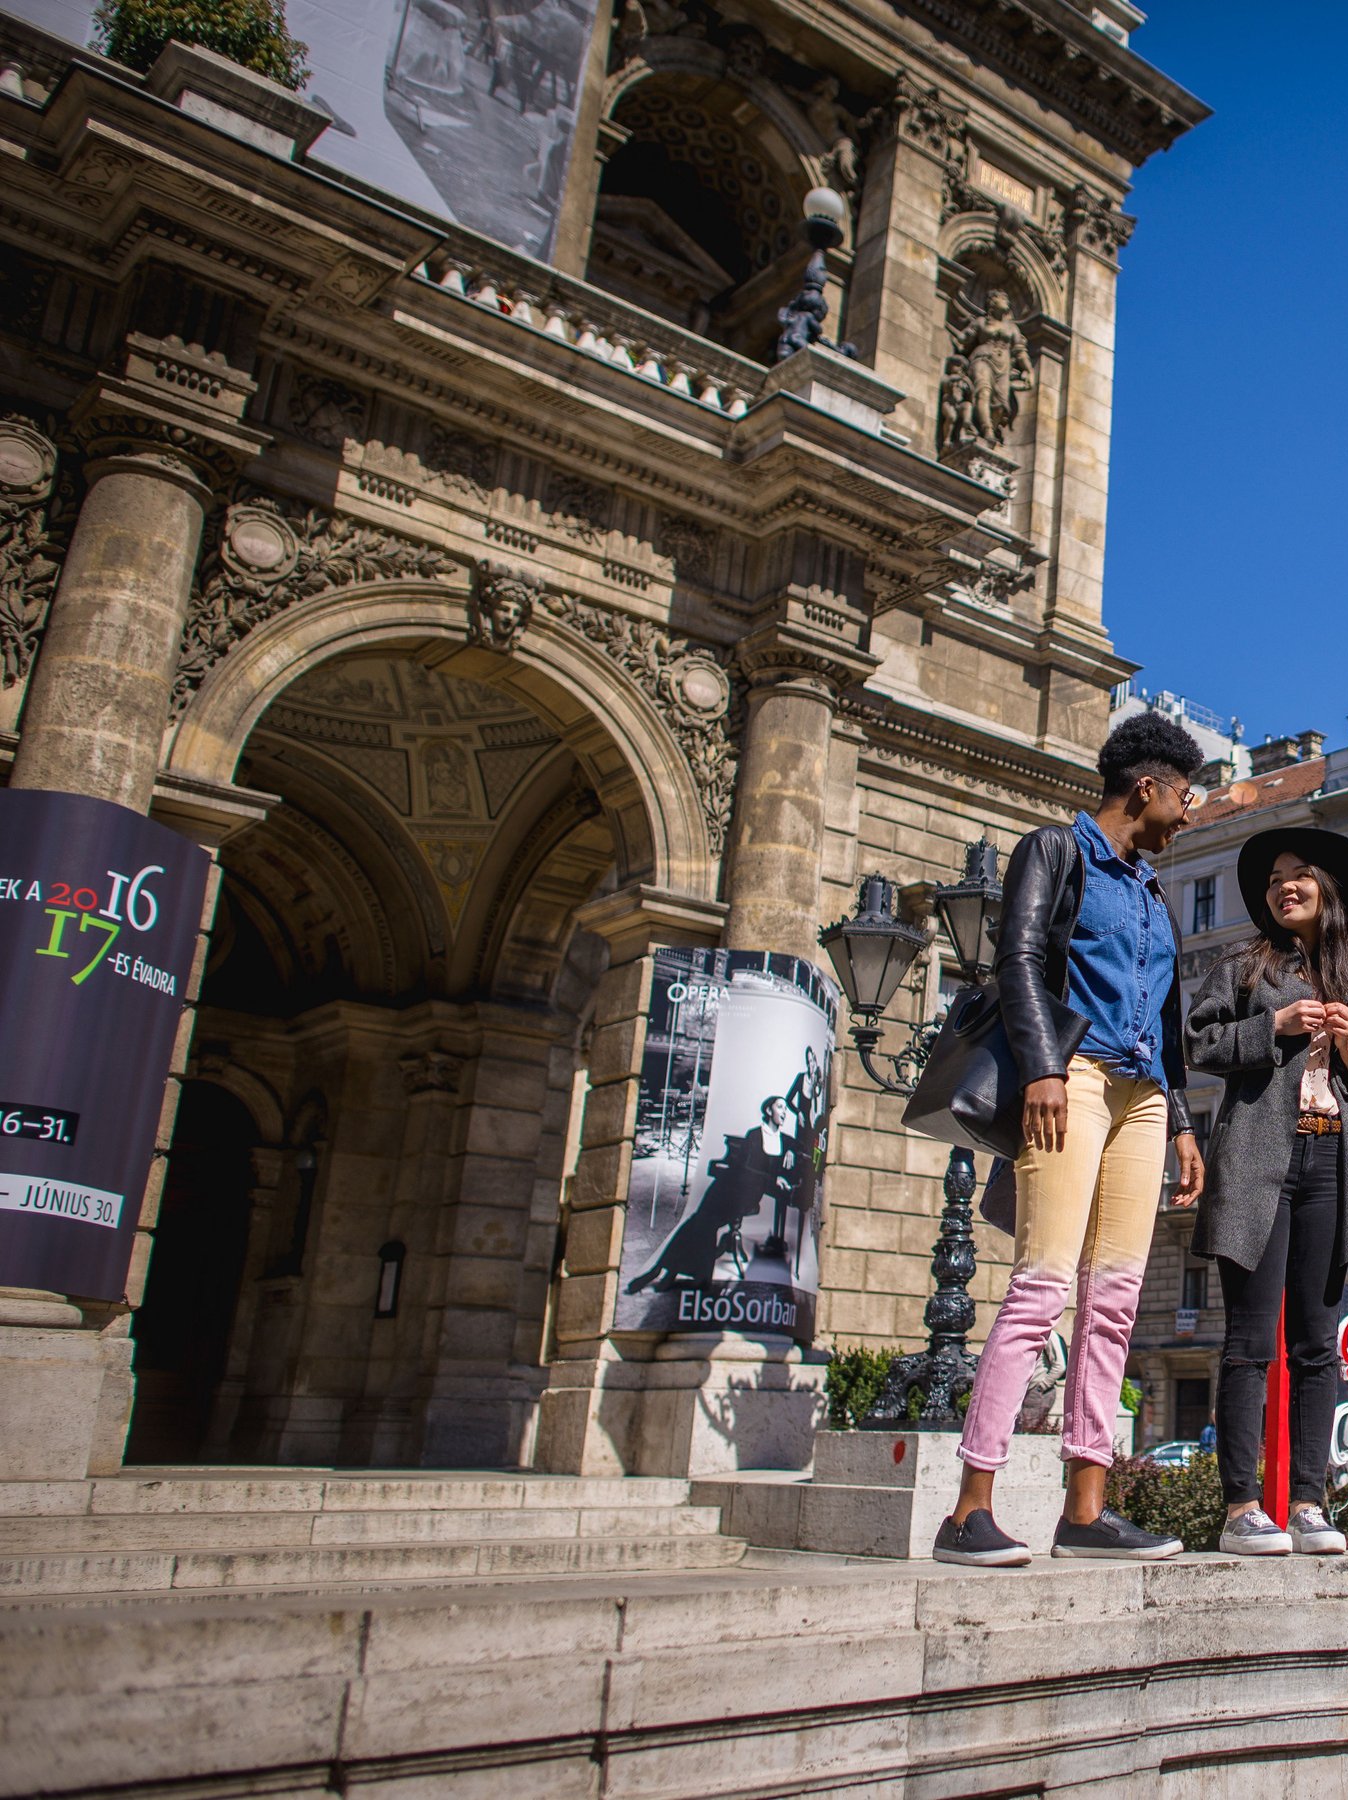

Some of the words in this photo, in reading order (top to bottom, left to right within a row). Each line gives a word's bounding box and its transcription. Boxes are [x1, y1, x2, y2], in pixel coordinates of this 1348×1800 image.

[25, 880, 41, 901] A
[131, 956, 177, 997] ÉVADRA
[667, 983, 731, 1003] OPERA
[19, 1181, 91, 1217] JÚNIUS
[94, 1200, 115, 1223] 30.
[678, 1288, 797, 1327] ElsőSorban
